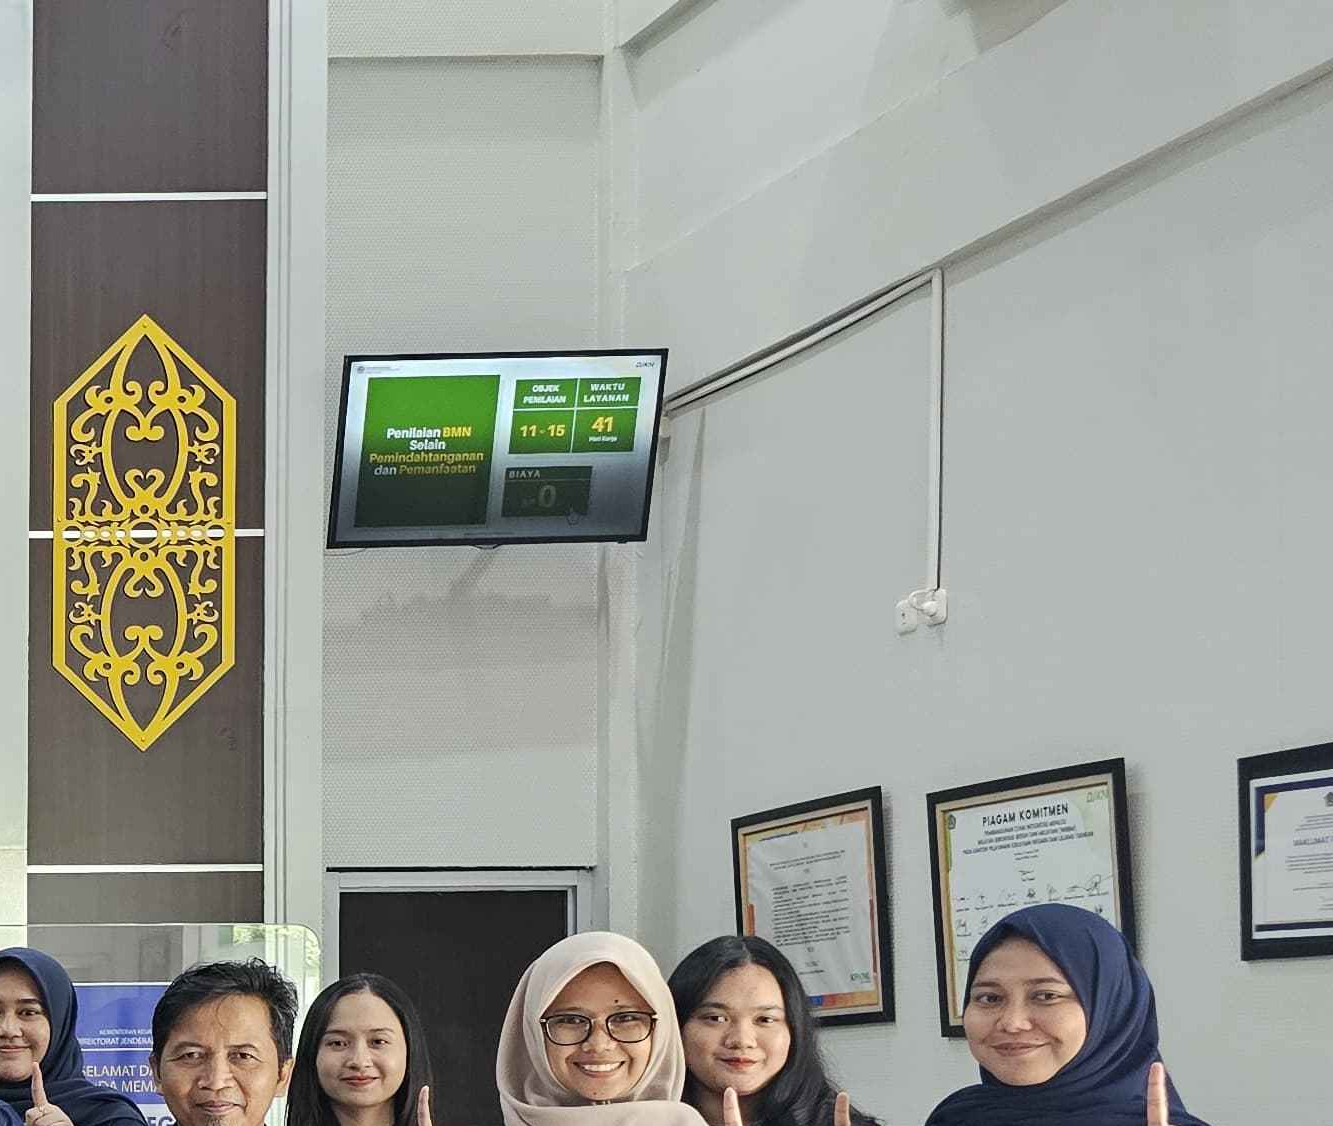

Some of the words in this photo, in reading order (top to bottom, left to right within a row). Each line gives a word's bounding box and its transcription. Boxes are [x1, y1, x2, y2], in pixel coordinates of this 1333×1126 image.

[591, 382, 625, 391] WAKTU
[583, 394, 630, 403] LAYANAN
[520, 425, 537, 437] 11
[547, 424, 566, 437] 15
[591, 416, 614, 433] 41
[386, 427, 442, 439] Penilaian
[442, 426, 472, 438] BMN
[409, 439, 446, 450] Selain
[369, 452, 484, 464] Pemindahtanganan
[374, 465, 397, 475] dan
[399, 463, 476, 475] Pemanfaatan
[508, 469, 541, 479] BIAYA
[982, 812, 1016, 828] PIAGAM
[1019, 802, 1069, 821] KOMITMEN
